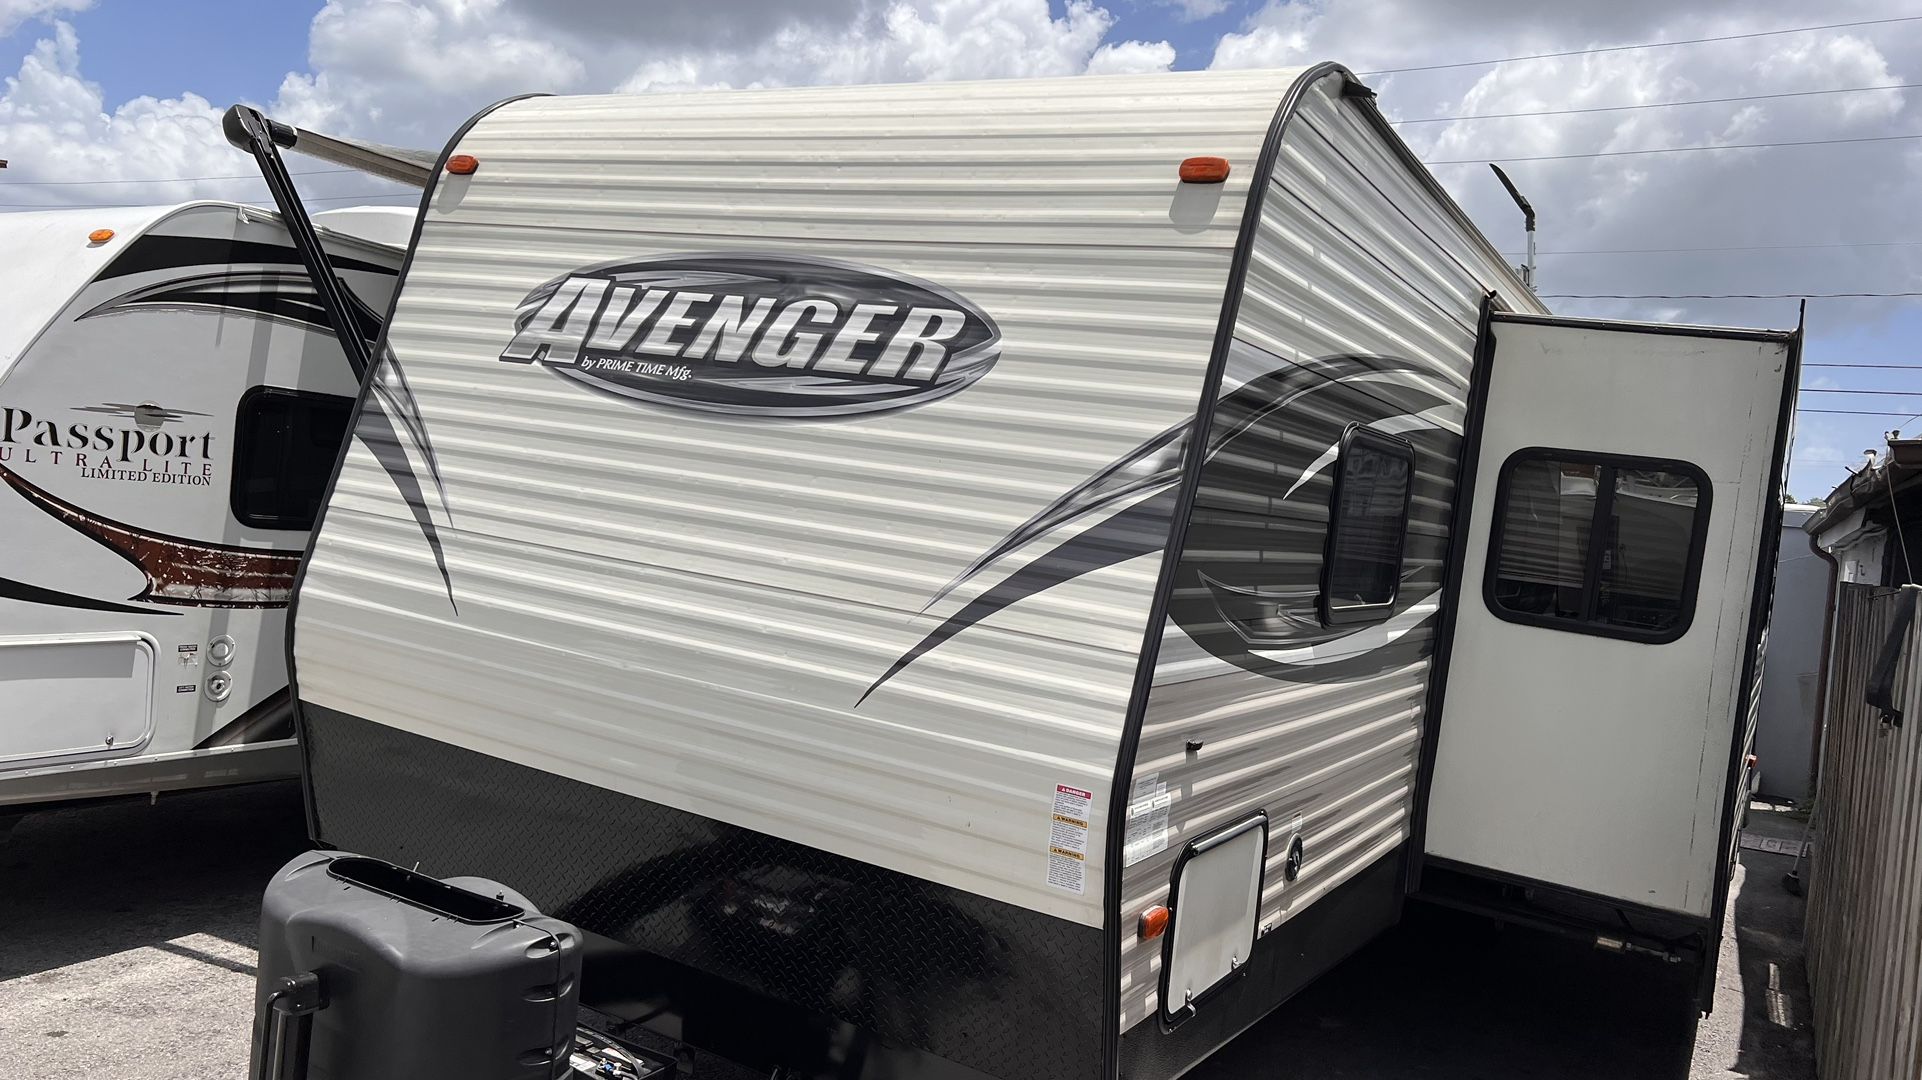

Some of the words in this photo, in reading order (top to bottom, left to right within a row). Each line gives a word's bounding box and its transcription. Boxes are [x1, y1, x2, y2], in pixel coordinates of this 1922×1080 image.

[501, 275, 967, 384] AVENGER
[581, 356, 596, 370] by
[596, 358, 634, 373] PRIME
[635, 362, 666, 376] TIME
[665, 365, 692, 380] Mfg.
[1, 406, 215, 463] Passport
[0, 447, 112, 469] ULTRA
[143, 458, 211, 476] LITE
[81, 467, 148, 482] LIMITED
[152, 471, 212, 486] EDITION
